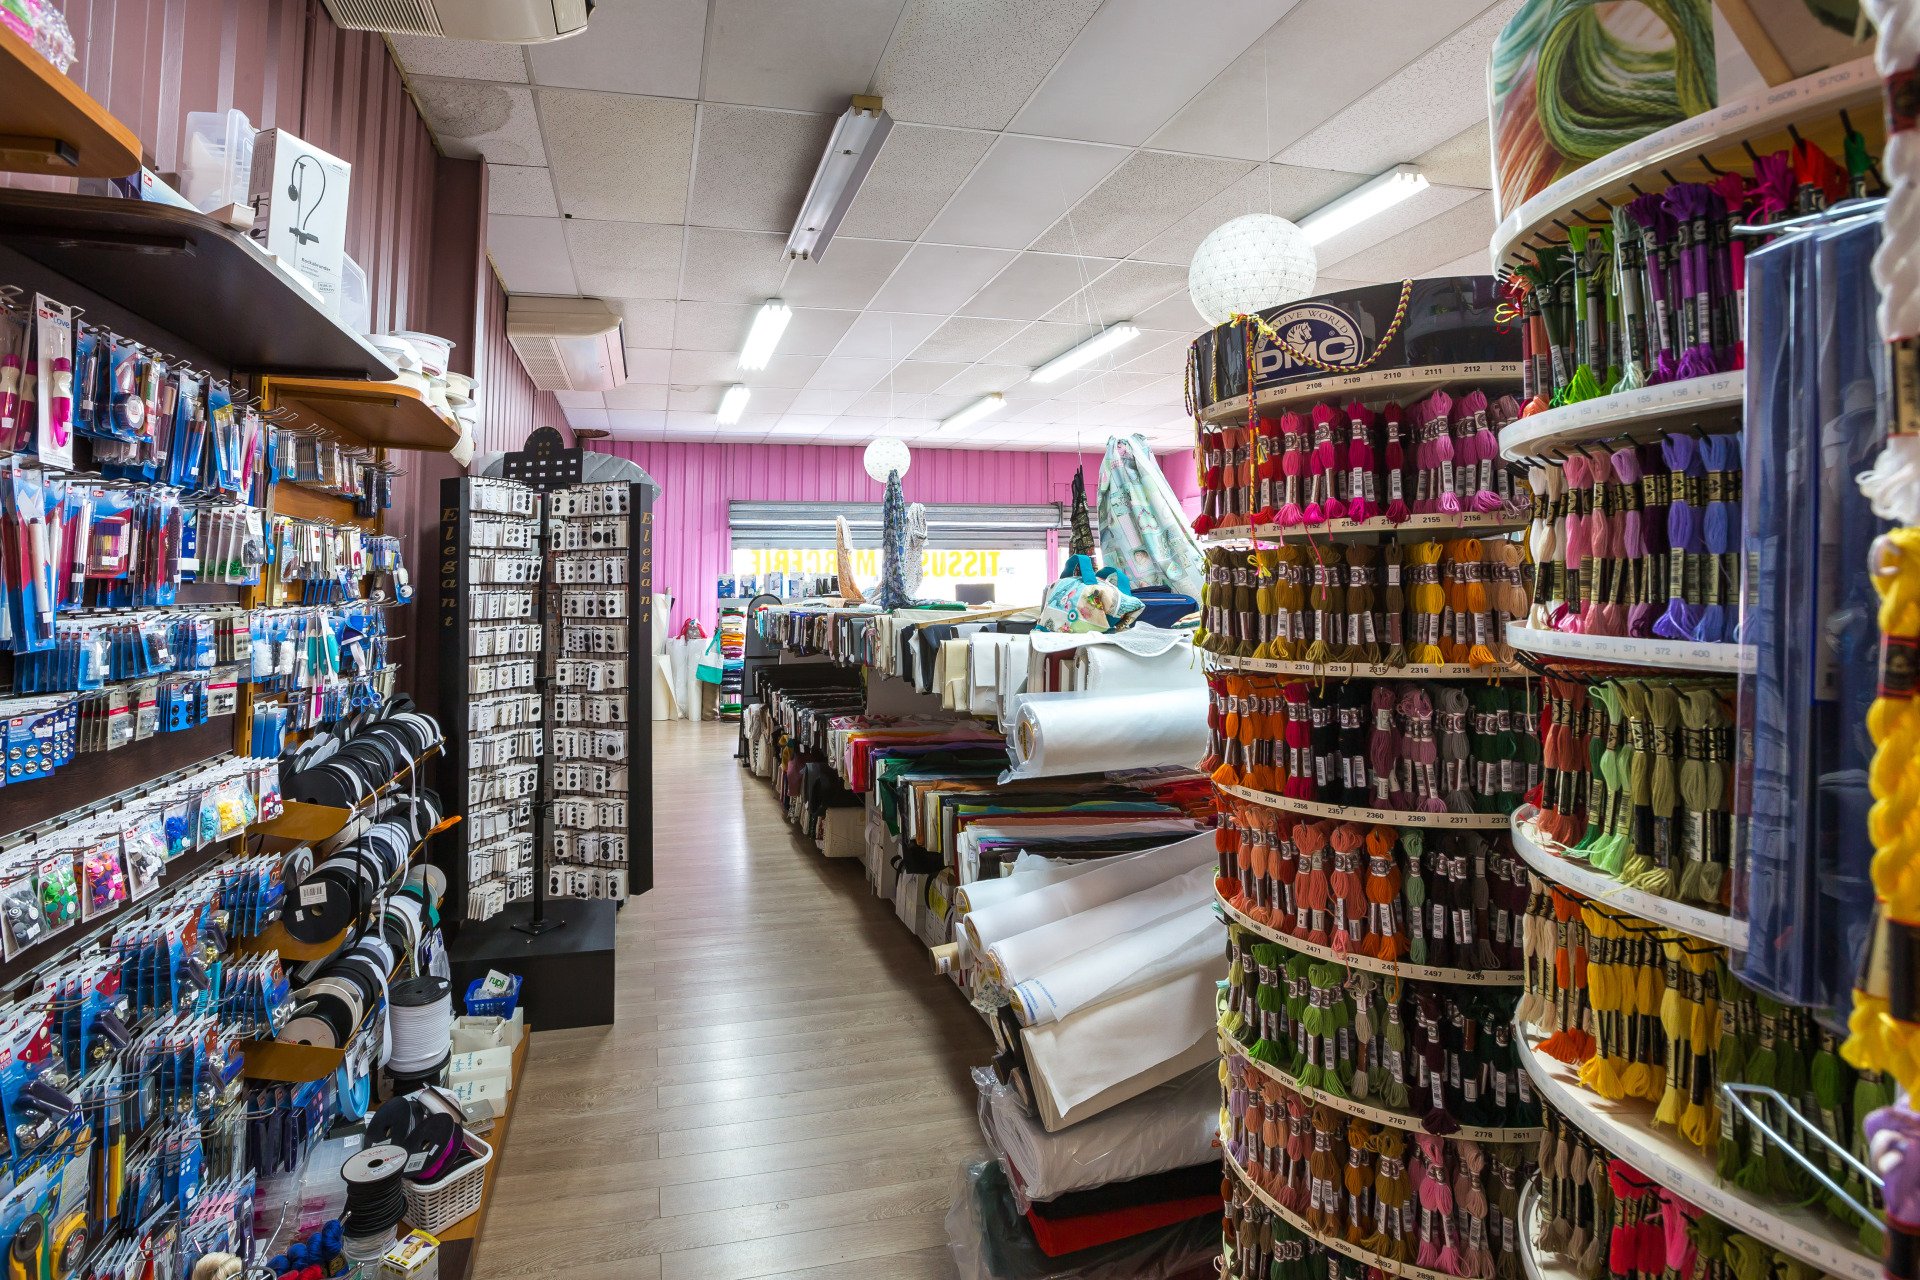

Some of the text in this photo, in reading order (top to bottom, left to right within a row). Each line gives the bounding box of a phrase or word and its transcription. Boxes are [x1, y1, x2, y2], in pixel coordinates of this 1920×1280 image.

[1257, 309, 1349, 350] CRATIVE WORLD
[1255, 335, 1356, 379] DMC
[1273, 387, 1287, 396] 2107
[1306, 382, 1323, 390] 2108
[1343, 376, 1361, 384] 2109
[1383, 371, 1402, 380] 2110
[1463, 365, 1481, 373] 2112
[1711, 381, 1729, 391] 157
[441, 508, 459, 627] Elegant
[640, 512, 653, 623] Elegant
[1655, 646, 1671, 655] 372
[1692, 649, 1710, 658] 400
[1327, 807, 1344, 815] 2357
[1366, 811, 1385, 820] 2360
[1407, 815, 1427, 823] 2369
[1275, 933, 1289, 943] 2470
[1306, 944, 1321, 954] 2471
[1343, 954, 1359, 964] 472
[1424, 970, 1442, 978] 2497
[1348, 1104, 1366, 1115] 2766
[1474, 1130, 1493, 1139] 2778
